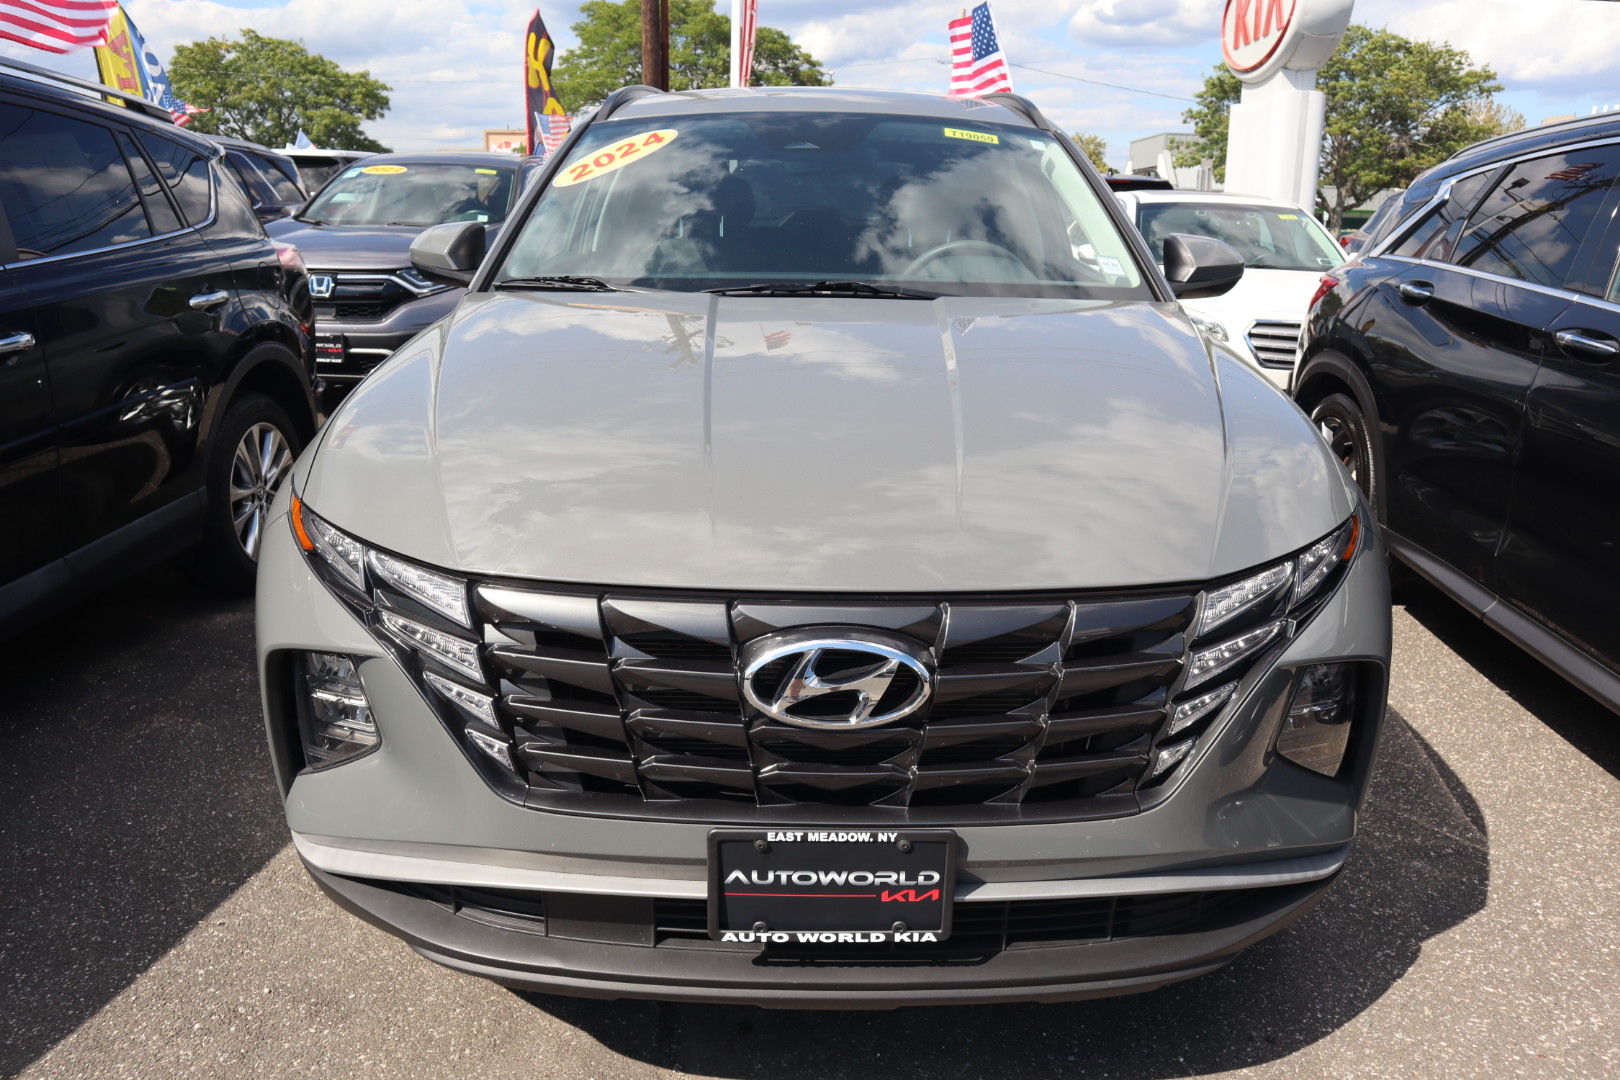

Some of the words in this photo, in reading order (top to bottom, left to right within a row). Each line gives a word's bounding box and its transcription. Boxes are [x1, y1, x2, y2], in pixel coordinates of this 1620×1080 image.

[950, 130, 994, 143] T19059
[569, 132, 665, 181] 2024
[767, 832, 803, 841] EAST
[877, 832, 898, 842] NY
[724, 869, 940, 886] AUTOWORLD
[881, 889, 940, 902] KIA
[721, 932, 790, 942] AUTO
[796, 932, 886, 942] WORLD
[894, 932, 938, 942] KIA
